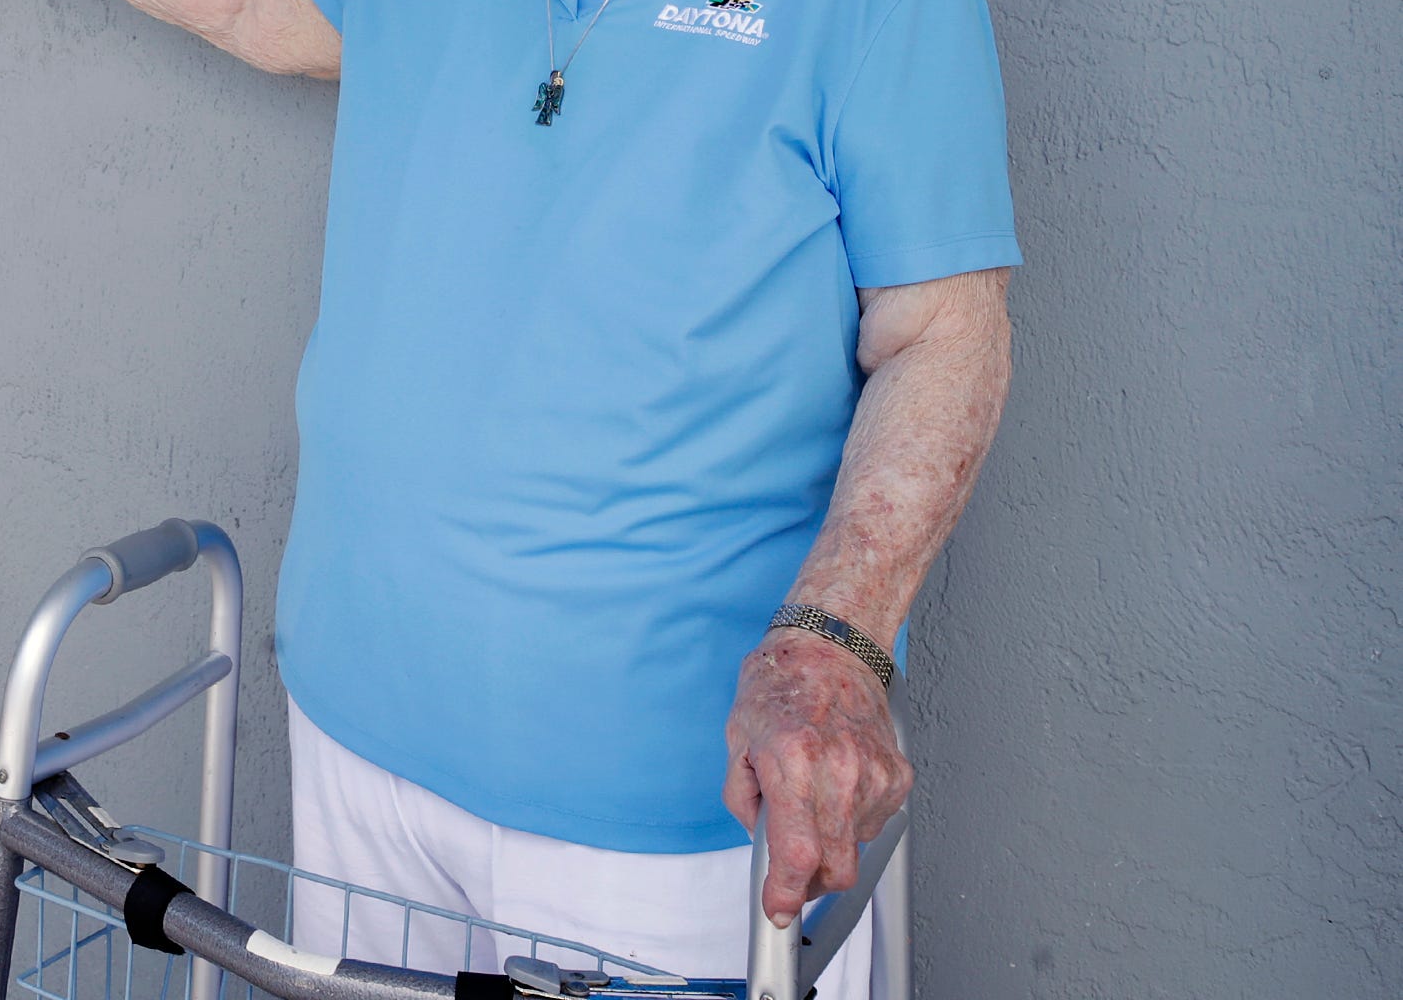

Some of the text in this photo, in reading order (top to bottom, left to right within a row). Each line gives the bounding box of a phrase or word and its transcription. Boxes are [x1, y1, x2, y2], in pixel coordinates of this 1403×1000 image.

[654, 21, 761, 46] INTERNATIONAL SPEEDWAY
[658, 5, 765, 37] DAYTONA
